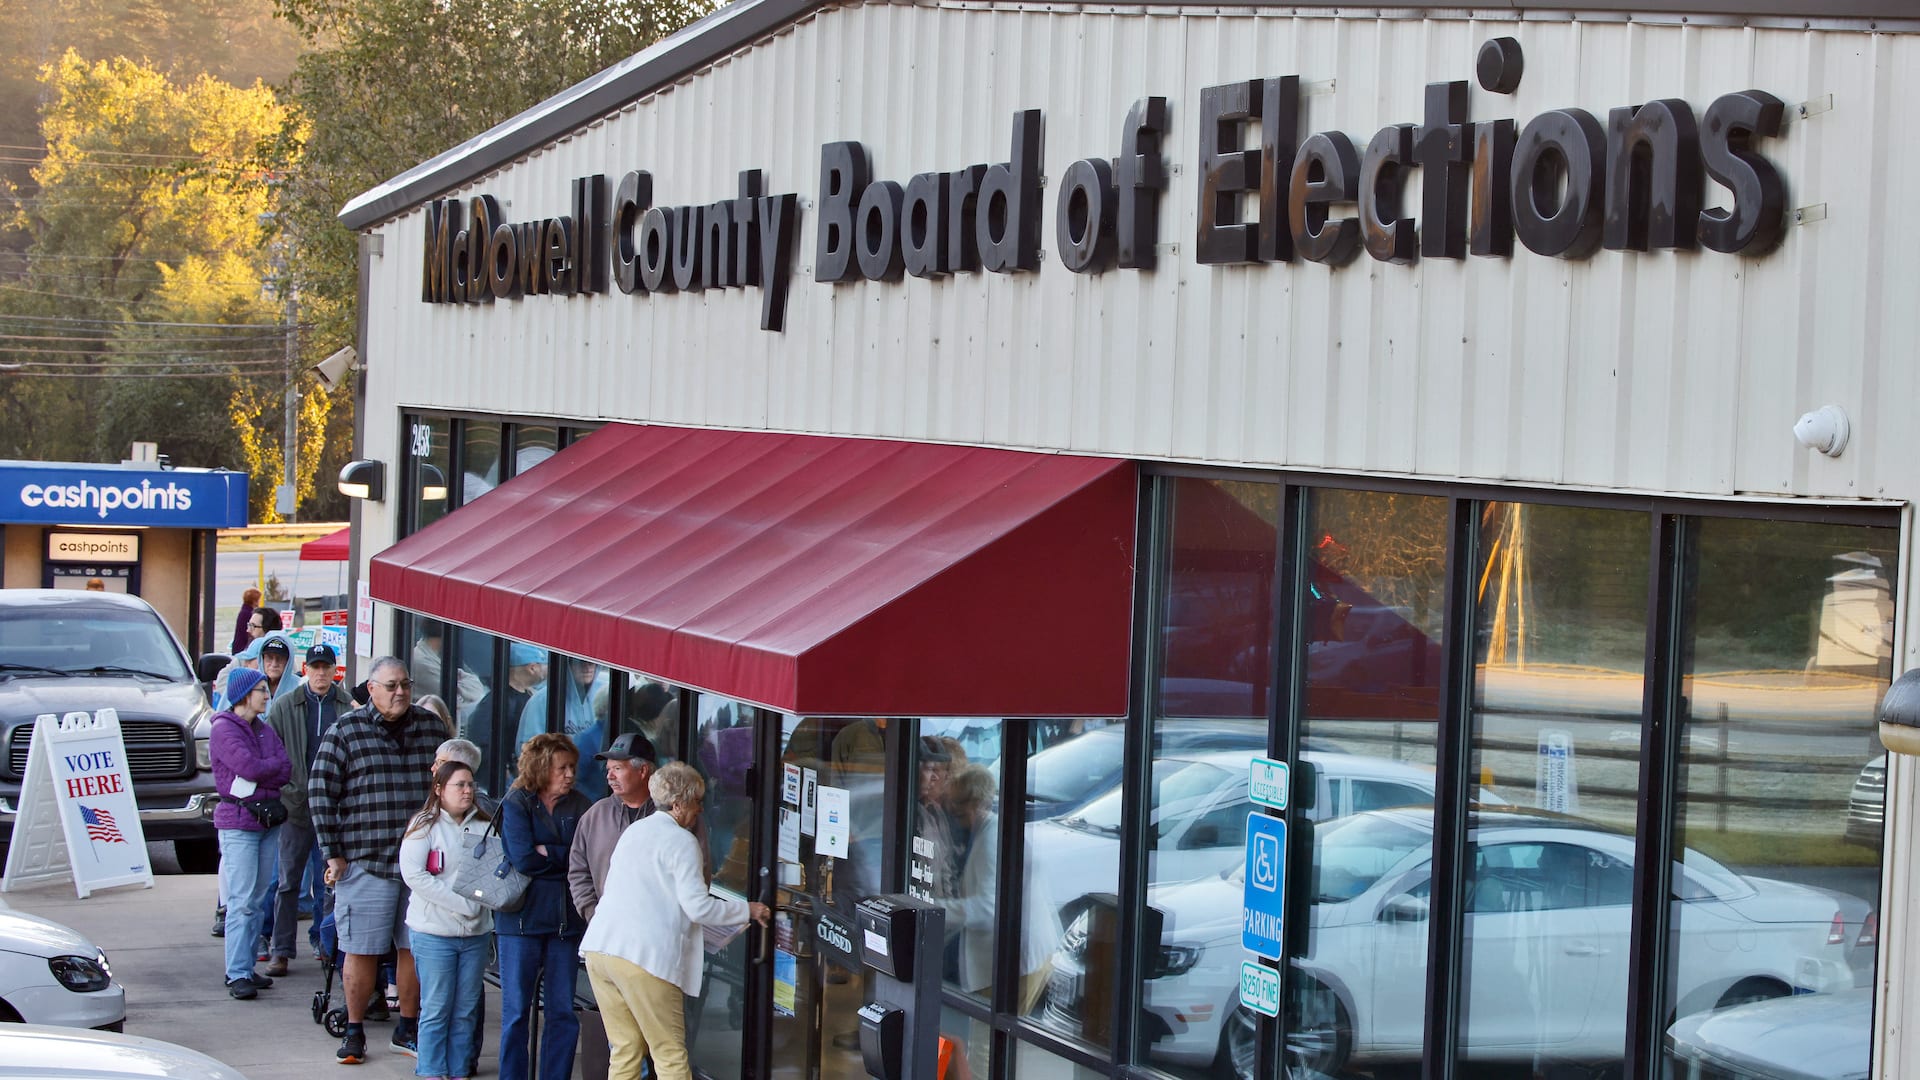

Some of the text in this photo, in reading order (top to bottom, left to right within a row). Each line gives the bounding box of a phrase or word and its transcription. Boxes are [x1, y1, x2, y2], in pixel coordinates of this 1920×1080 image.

[421, 36, 1787, 331] McDowell County Board of Elections
[411, 423, 431, 457] 2458
[20, 478, 192, 519] cashpoints
[59, 540, 129, 555] cashpoints
[322, 632, 342, 644] BAKE
[64, 751, 114, 773] VOTE
[1264, 767, 1274, 781] VAN
[65, 773, 124, 798] HERE
[1253, 781, 1284, 801] ACCESSIBLE
[817, 923, 852, 953] CLOSED
[1243, 907, 1281, 942] PARKING
[1243, 974, 1277, 1004] $250 FINE
